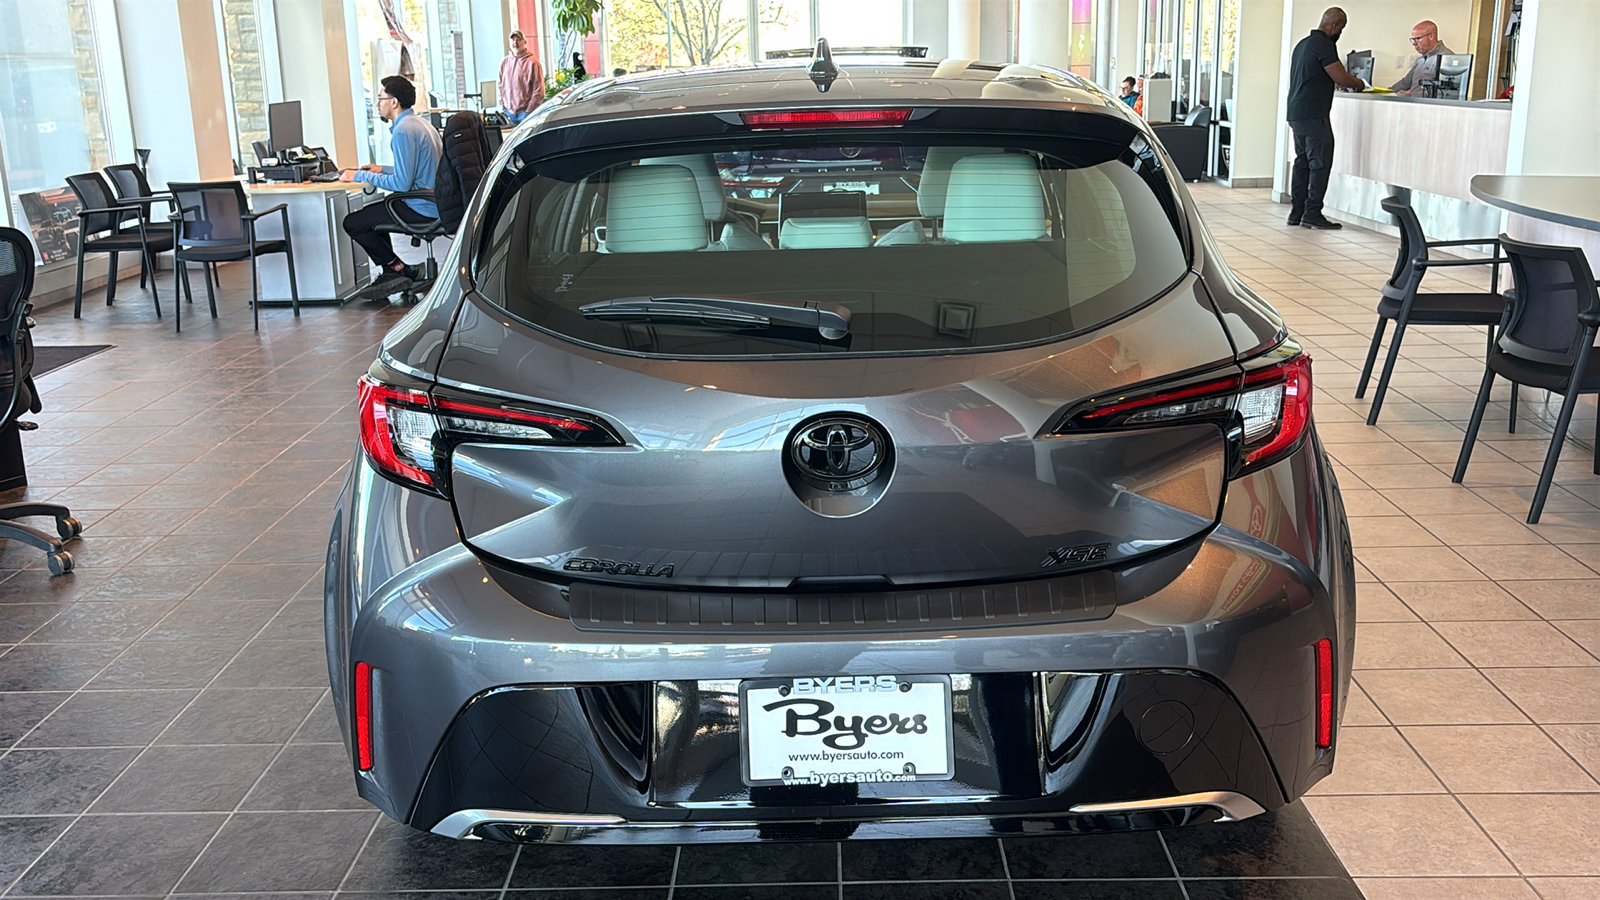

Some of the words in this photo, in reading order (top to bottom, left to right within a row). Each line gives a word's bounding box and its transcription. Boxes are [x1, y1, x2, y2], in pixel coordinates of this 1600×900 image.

[1041, 542, 1112, 568] XSE
[563, 557, 674, 578] COROLLA
[793, 675, 897, 694] BYERS
[762, 698, 928, 750] Byers
[788, 750, 904, 763] www.byersauto.com
[784, 769, 915, 787] www.byersauto.com
